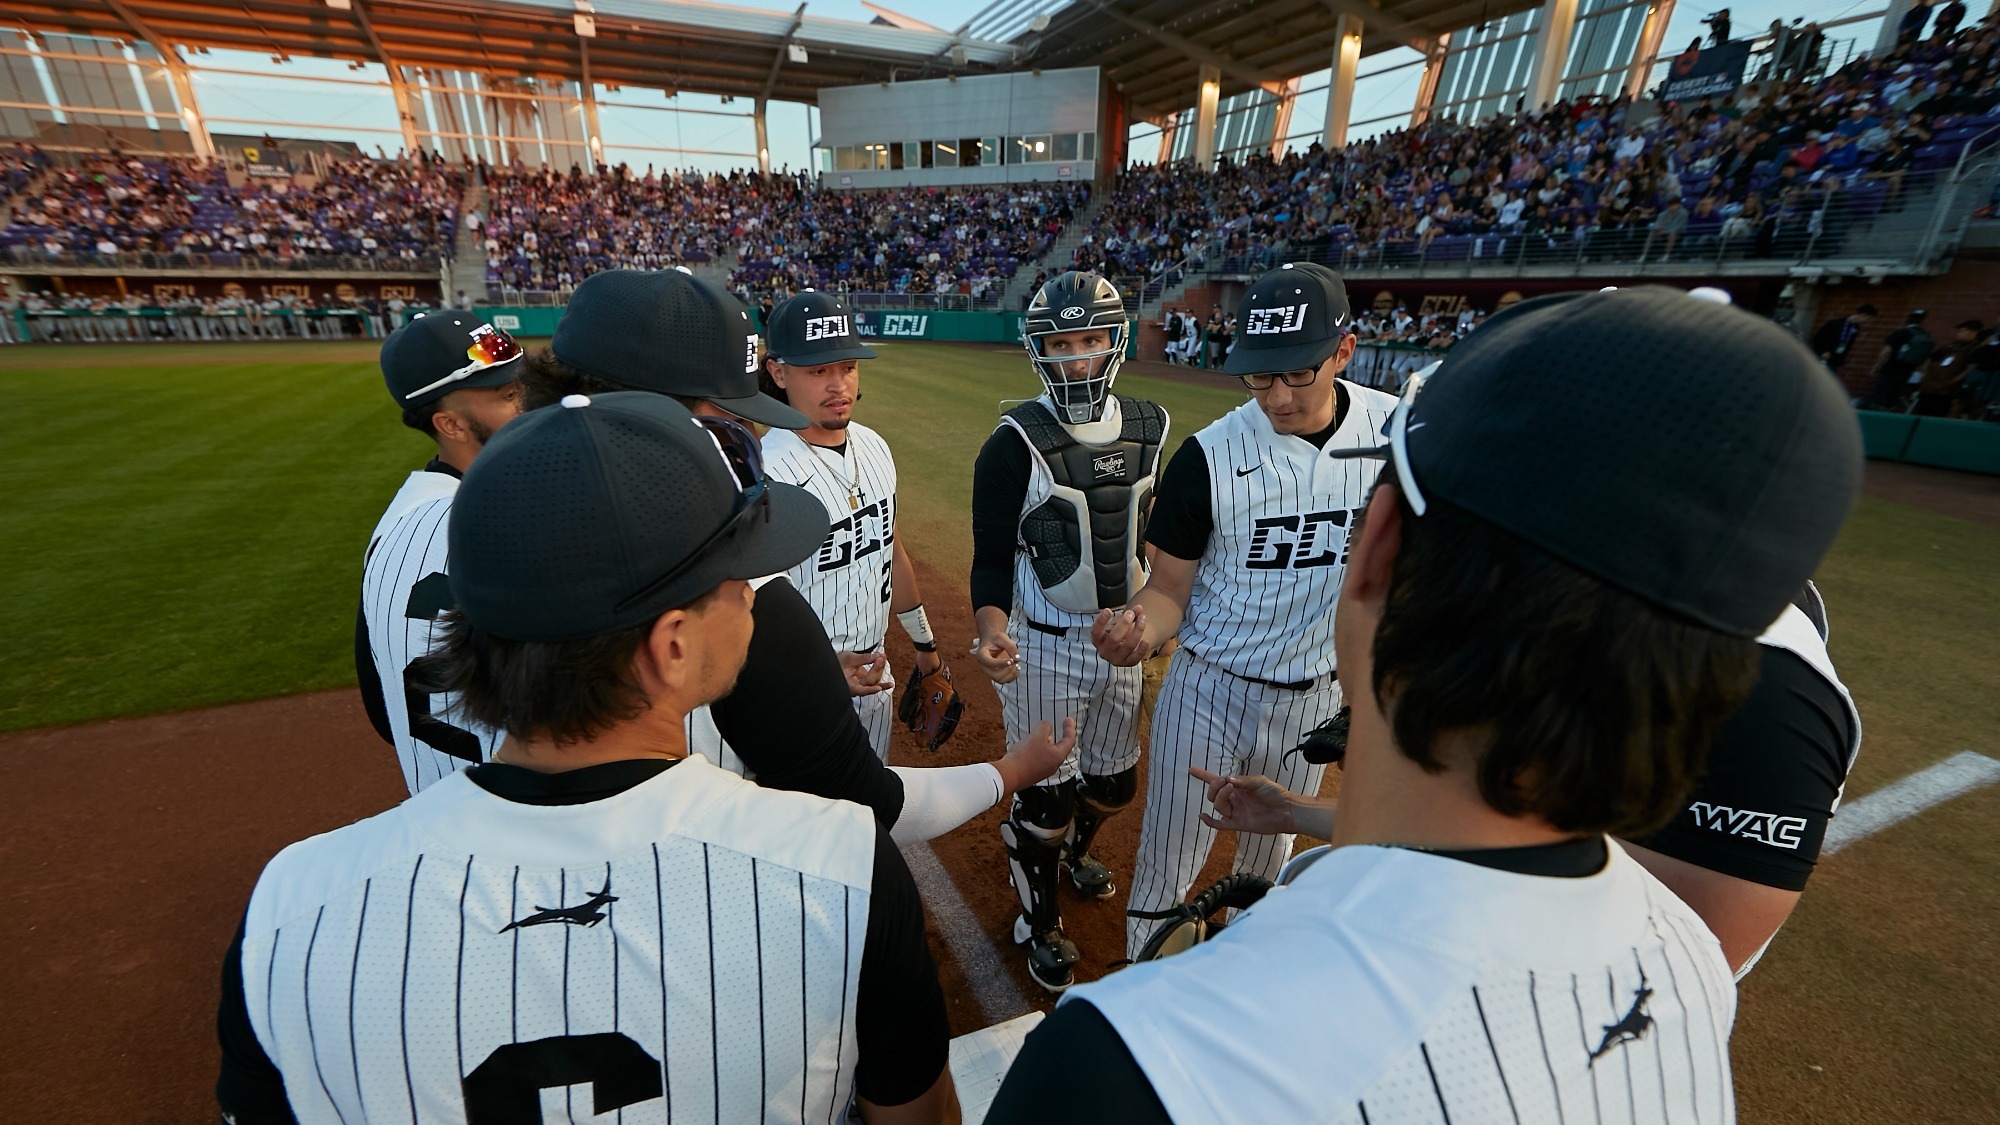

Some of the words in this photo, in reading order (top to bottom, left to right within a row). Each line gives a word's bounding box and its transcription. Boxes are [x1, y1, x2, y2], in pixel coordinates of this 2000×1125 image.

[805, 314, 850, 342] GCU
[857, 324, 876, 335] NAL
[883, 314, 928, 336] GCU
[1246, 303, 1309, 335] GCU
[818, 493, 897, 573] GCU
[1688, 801, 1808, 850] WAC
